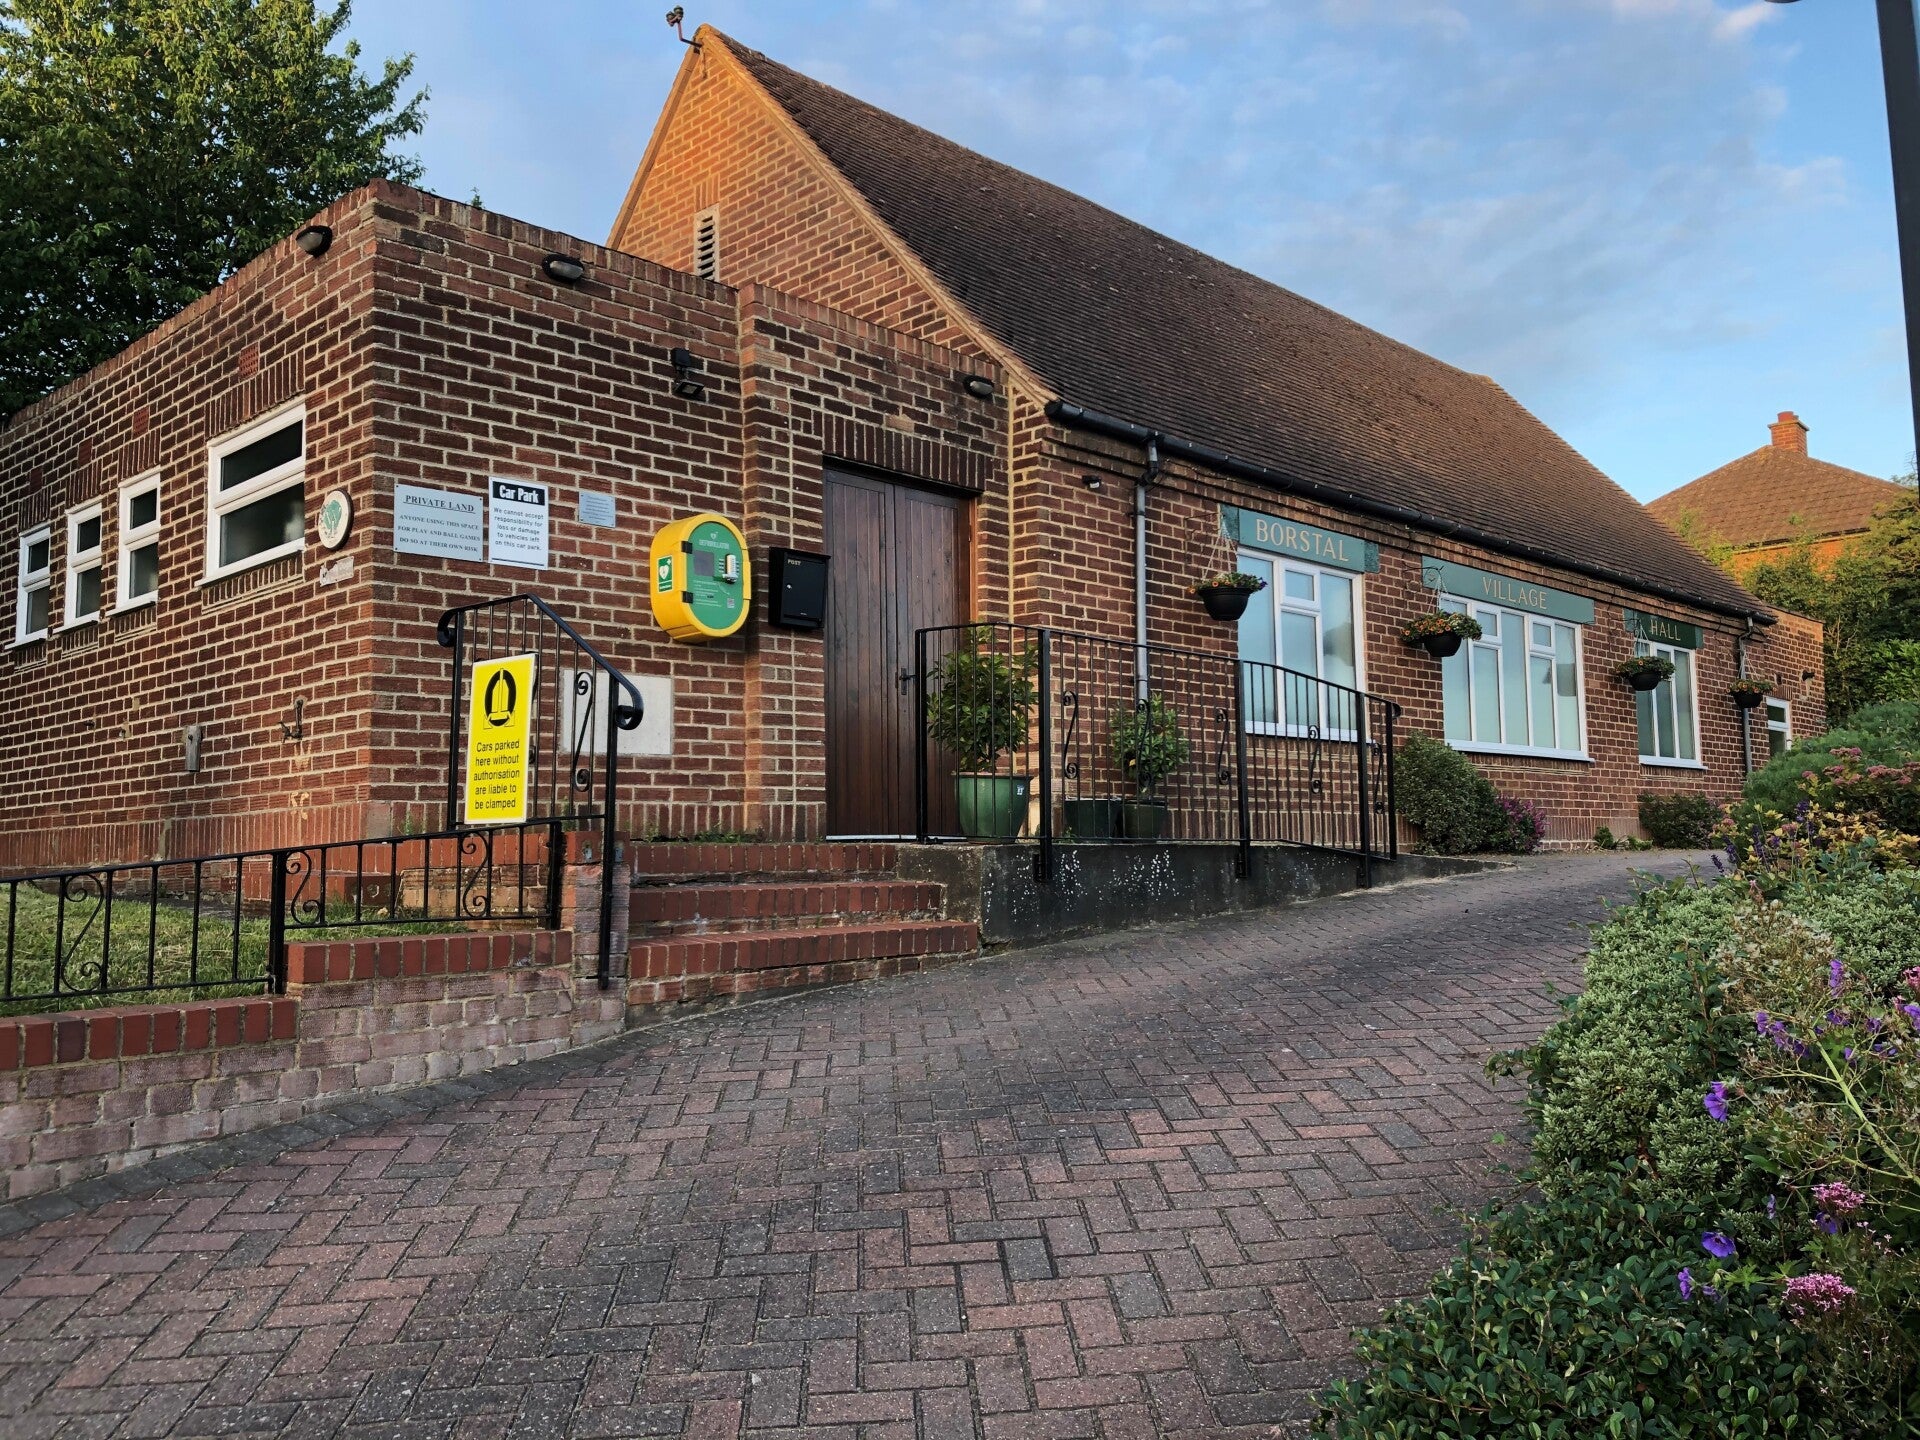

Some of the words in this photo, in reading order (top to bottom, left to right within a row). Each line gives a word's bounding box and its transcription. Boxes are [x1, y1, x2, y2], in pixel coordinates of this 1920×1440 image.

[499, 484, 516, 499] Car
[517, 487, 539, 503] Park
[405, 494, 446, 508] PRIVATE
[448, 501, 475, 512] LAND
[503, 509, 523, 517] cannot
[399, 514, 425, 523] ANYONE
[426, 518, 445, 526] USING
[446, 520, 460, 528] THIS
[460, 522, 479, 530] SPACE
[494, 516, 534, 526] responsibility
[443, 530, 458, 538] BALL
[459, 533, 480, 541] GAMES
[504, 533, 529, 541] vehicles
[517, 527, 540, 536] damage
[428, 540, 448, 549] THEIR
[1256, 518, 1349, 562] BORSTAL
[1482, 576, 1547, 610] VILLAGE
[1650, 619, 1681, 642] HALL
[476, 742, 493, 752] Cars
[494, 739, 520, 753] parked
[475, 757, 491, 767] here
[493, 754, 519, 765] without
[473, 769, 520, 781] authorisation
[475, 786, 487, 795] are
[488, 783, 508, 795] liable
[509, 783, 517, 793] to
[474, 799, 484, 810] be
[485, 797, 516, 811] clamped
